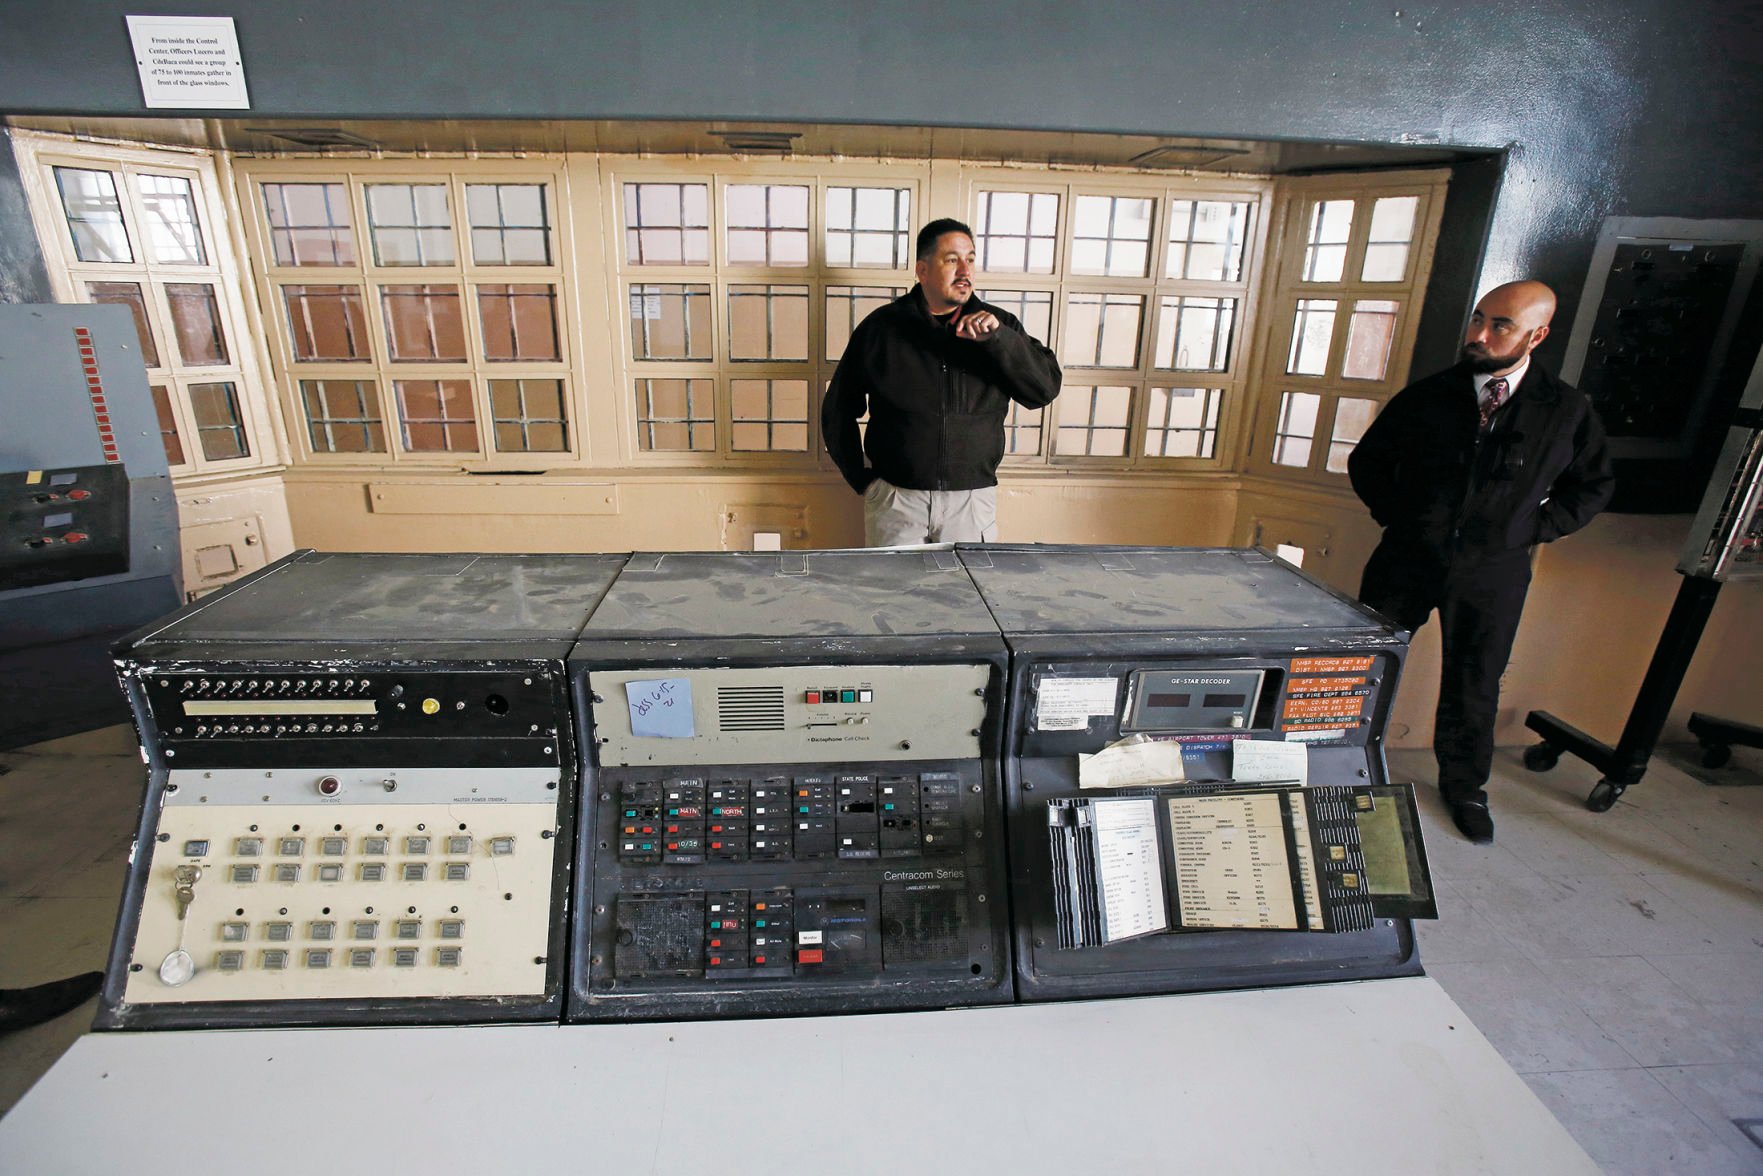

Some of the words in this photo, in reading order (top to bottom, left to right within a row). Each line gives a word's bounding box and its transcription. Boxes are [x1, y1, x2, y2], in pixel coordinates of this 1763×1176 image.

[196, 37, 218, 45] Control
[721, 808, 743, 816] NORTH
[884, 871, 934, 881] Centracom
[936, 869, 965, 879] Series
